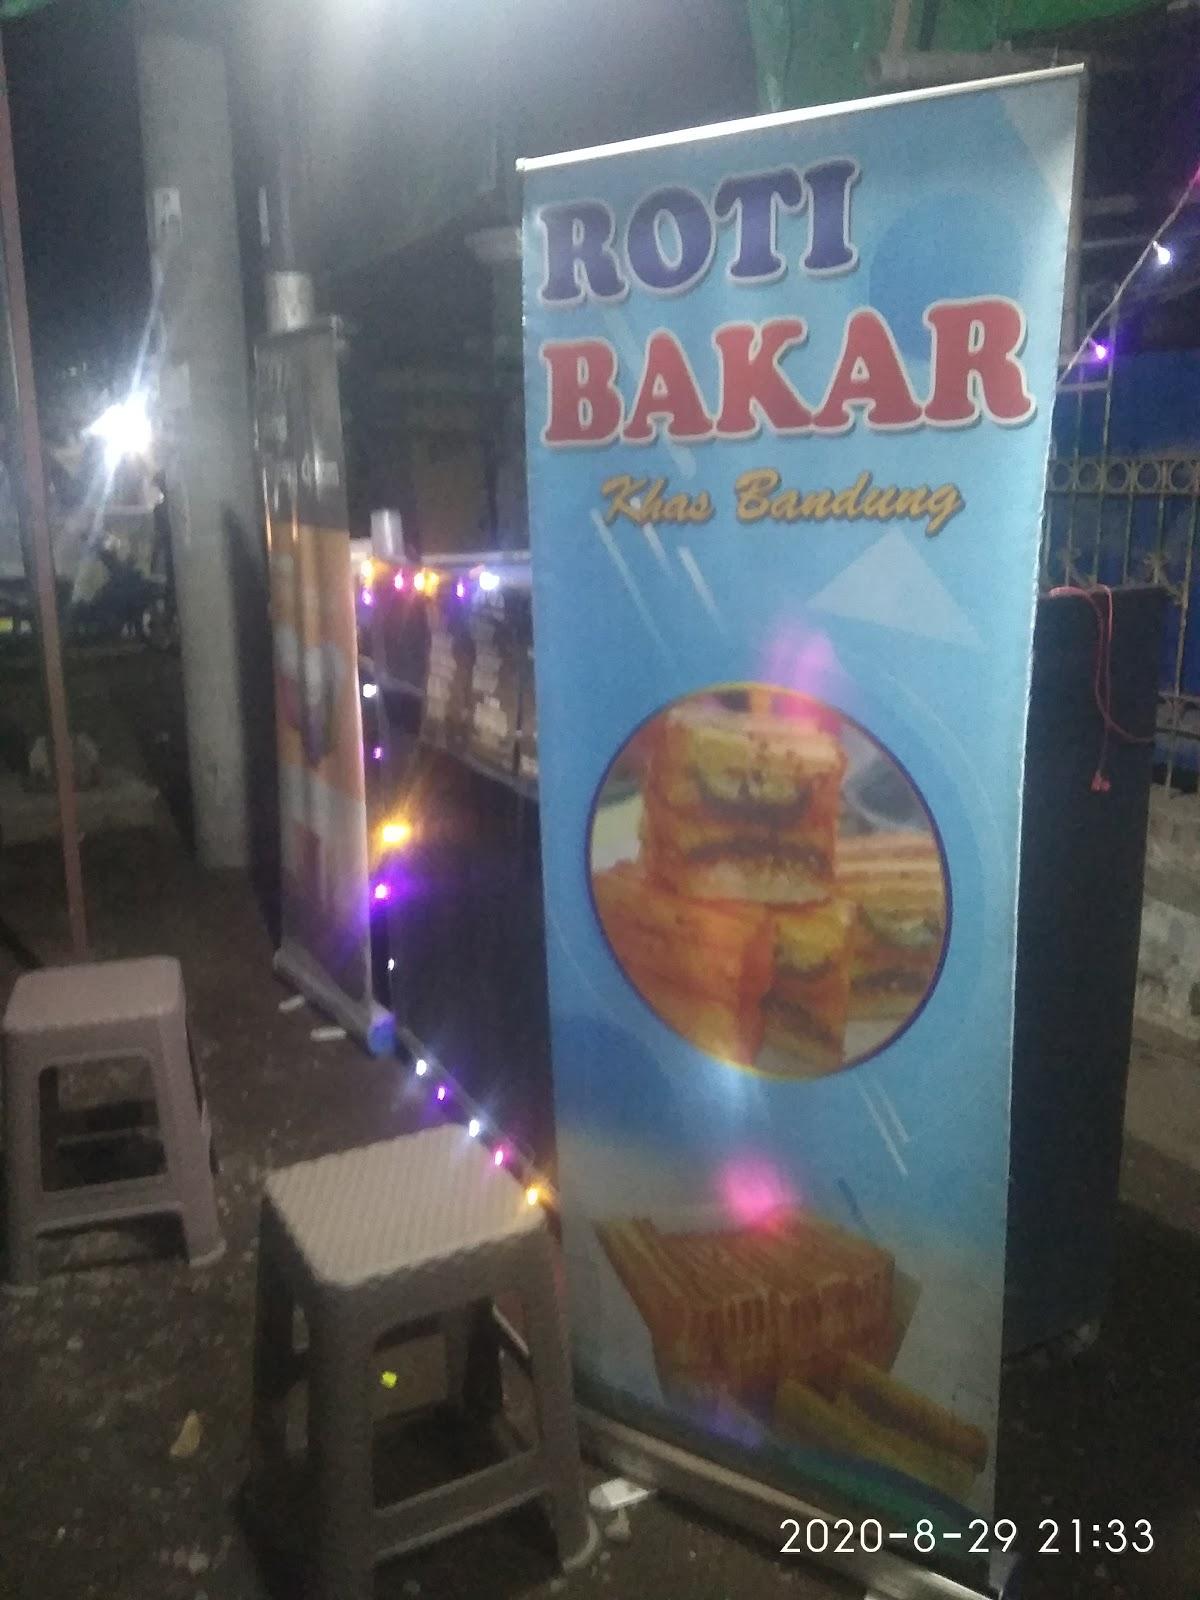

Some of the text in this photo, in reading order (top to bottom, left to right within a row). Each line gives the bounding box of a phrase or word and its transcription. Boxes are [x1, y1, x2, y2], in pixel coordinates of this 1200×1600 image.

[540, 160, 860, 305] ROTI
[540, 295, 1036, 448] BAKAR
[601, 467, 965, 538] Khas Bandung
